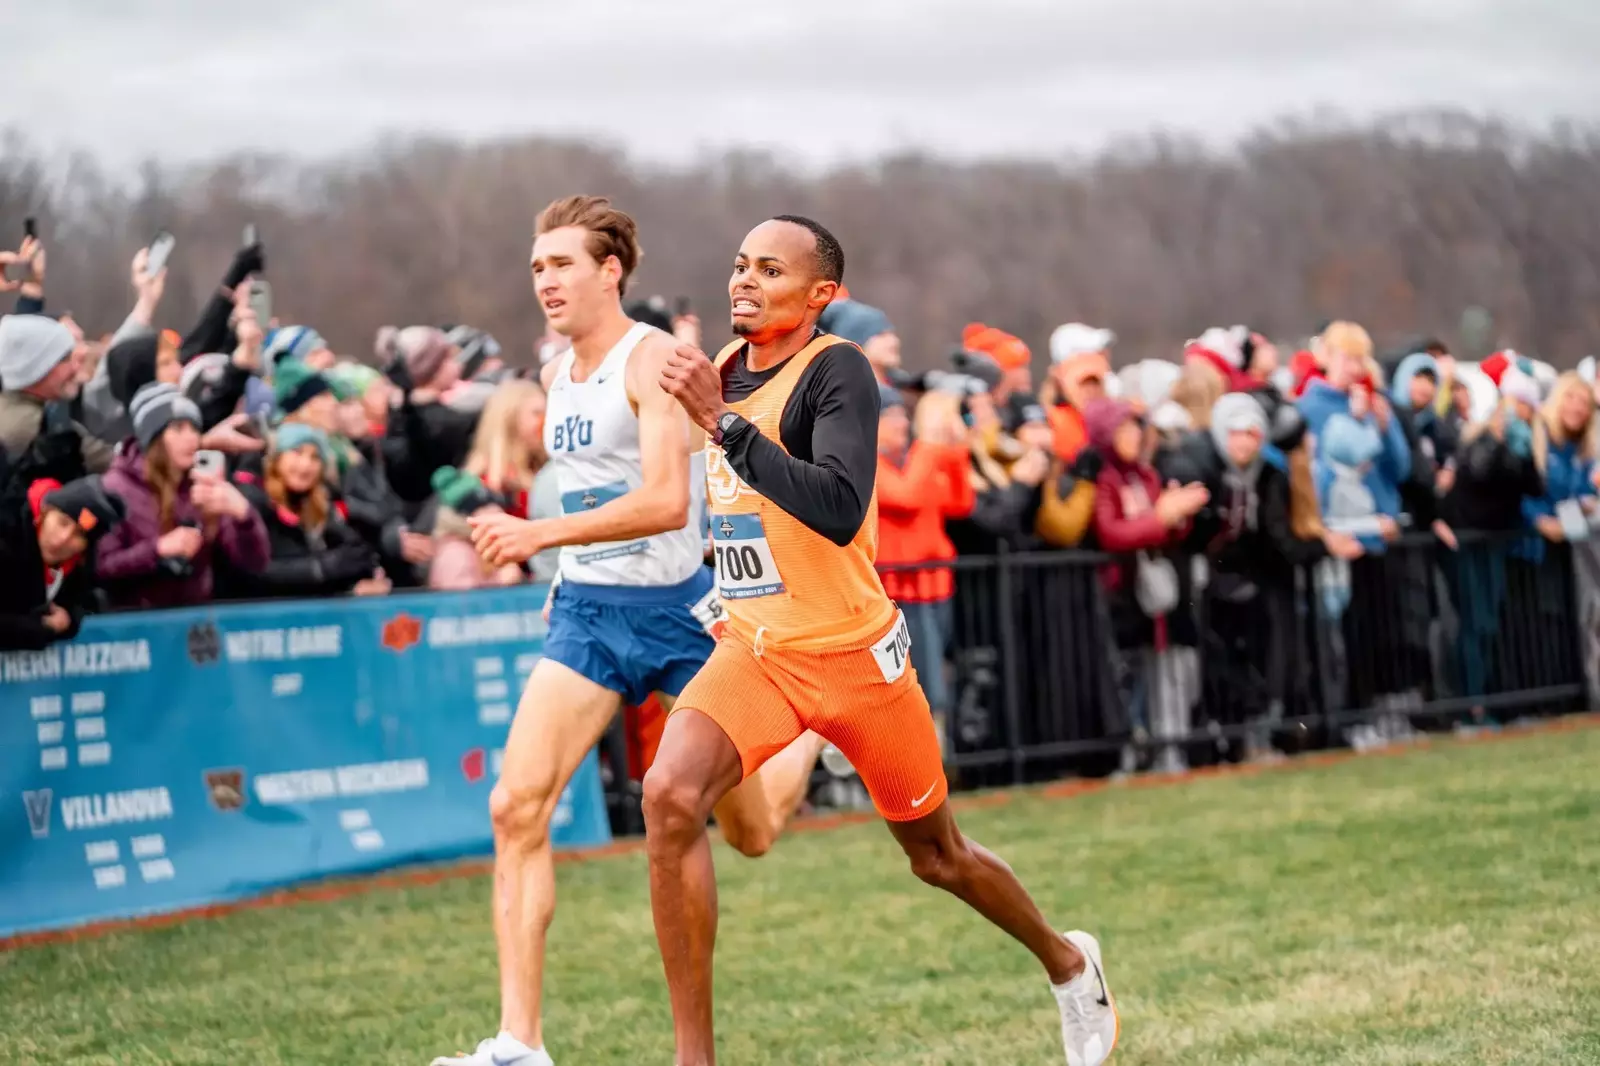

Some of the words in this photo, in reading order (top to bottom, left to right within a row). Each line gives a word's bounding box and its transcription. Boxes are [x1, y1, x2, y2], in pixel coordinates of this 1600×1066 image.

[553, 414, 594, 452] BYU
[716, 545, 764, 582] 700
[0, 647, 61, 682] HERN
[61, 786, 173, 830] VILLANOVA
